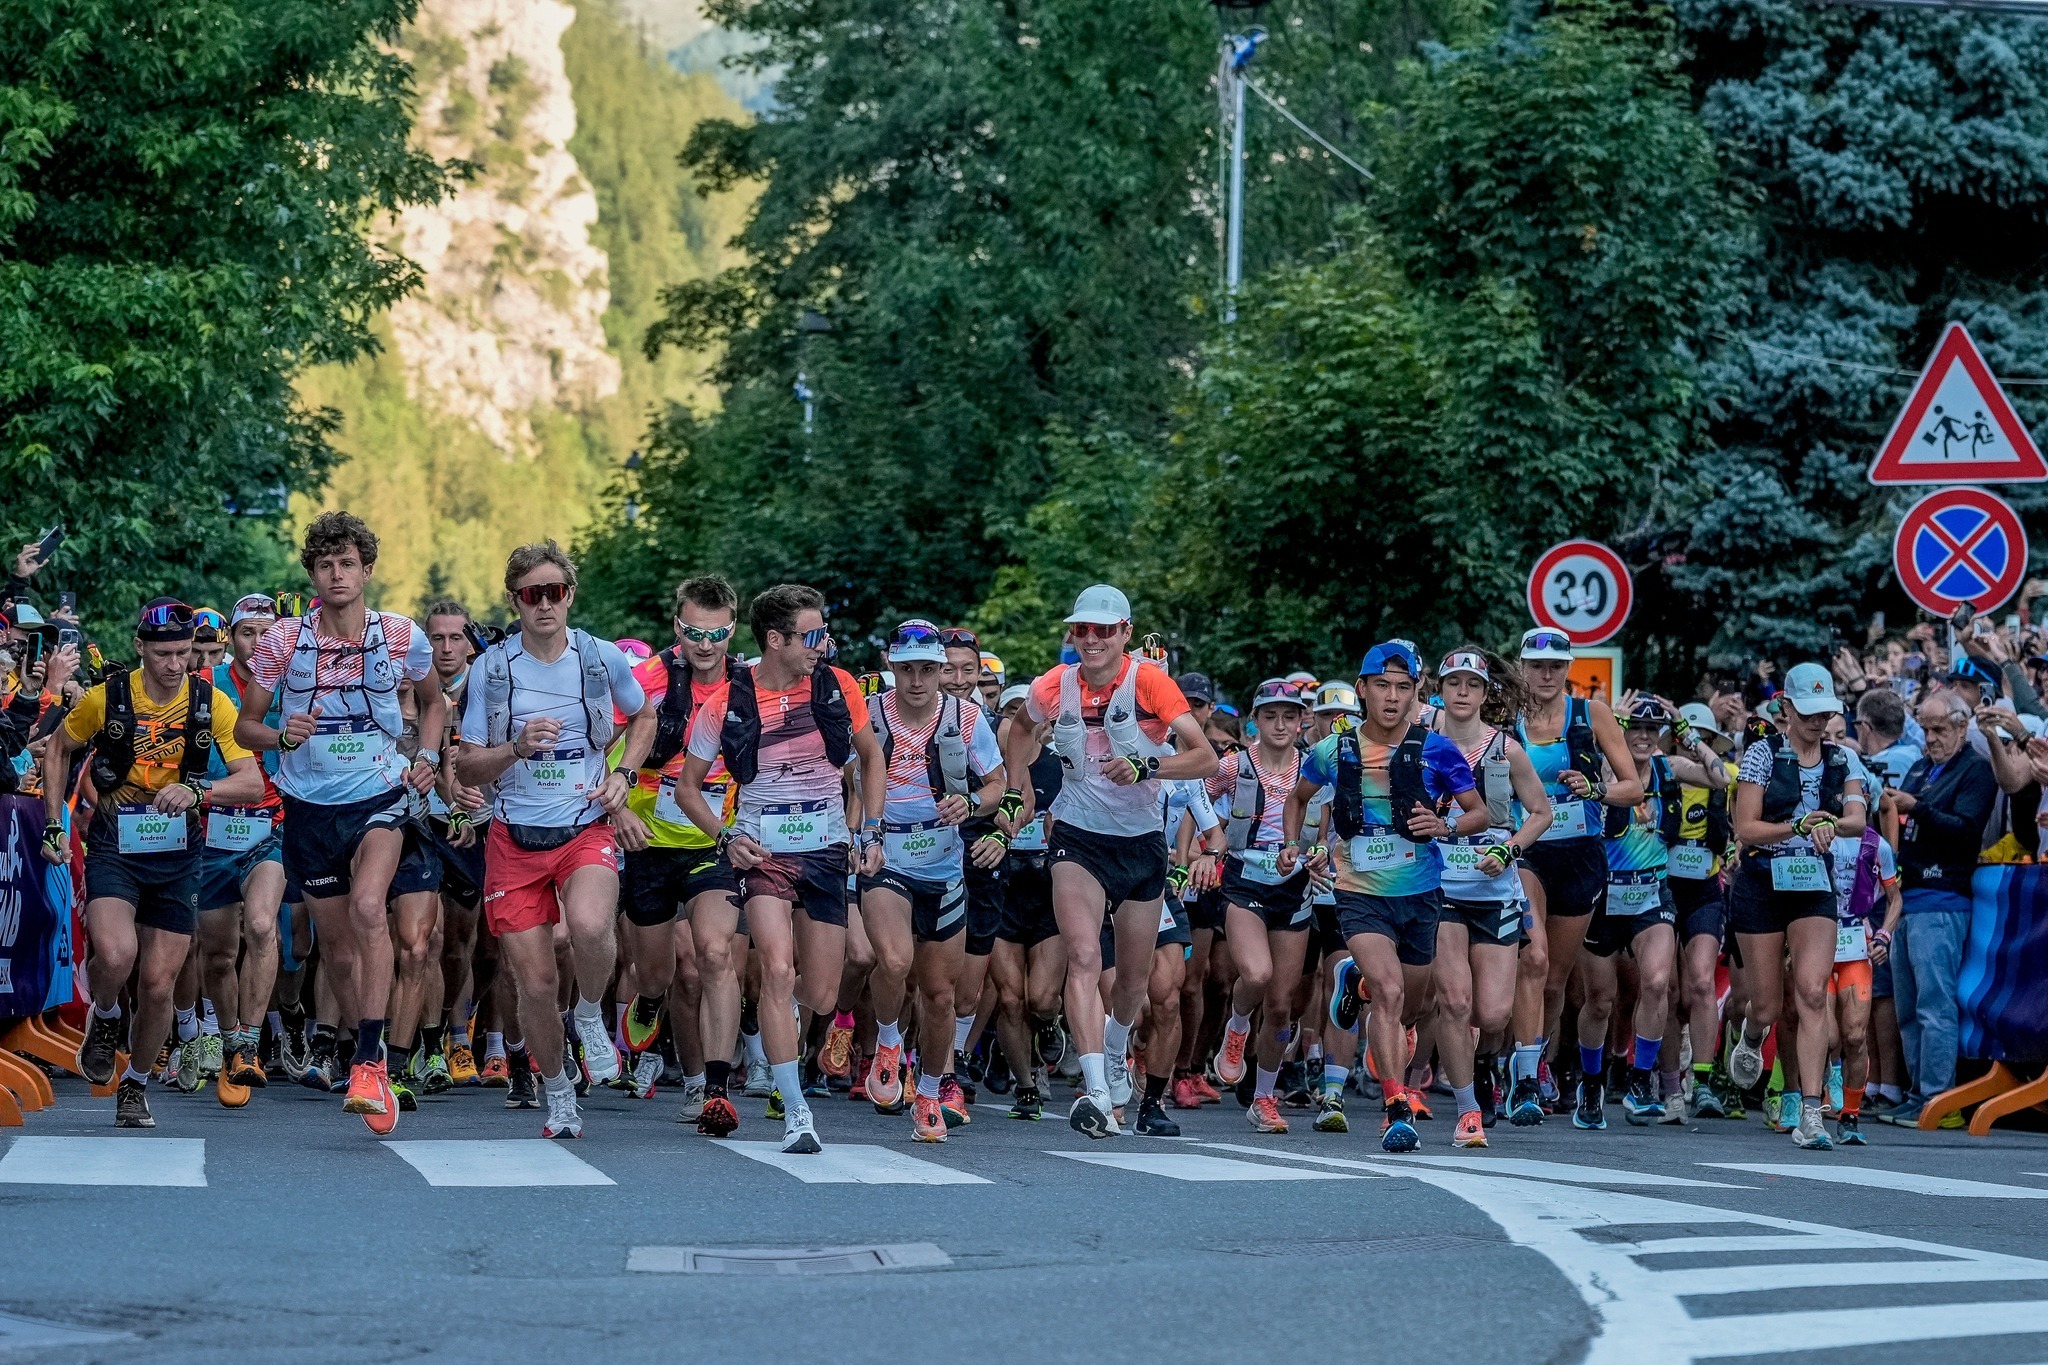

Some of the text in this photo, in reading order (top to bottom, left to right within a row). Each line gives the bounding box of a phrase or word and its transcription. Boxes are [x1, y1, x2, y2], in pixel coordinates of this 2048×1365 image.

[1554, 570, 1607, 616] 30
[327, 741, 365, 754] 4022
[532, 769, 566, 780] 4014
[1554, 811, 1569, 821] 48
[1688, 809, 1704, 819] BOA
[135, 821, 170, 835] 4007
[224, 824, 251, 835] 4151
[777, 821, 814, 835] 4046
[139, 834, 167, 842] Andreas
[226, 834, 249, 842] Andrea
[910, 832, 924, 840] CCC
[902, 836, 937, 851] 4002
[1366, 842, 1394, 854] 4011
[910, 849, 929, 857] Petter
[1446, 853, 1479, 864] 4005
[1676, 853, 1703, 864] 4060
[1787, 865, 1817, 874] 4035
[311, 876, 338, 886] TERREX
[1622, 891, 1648, 901] 4029
